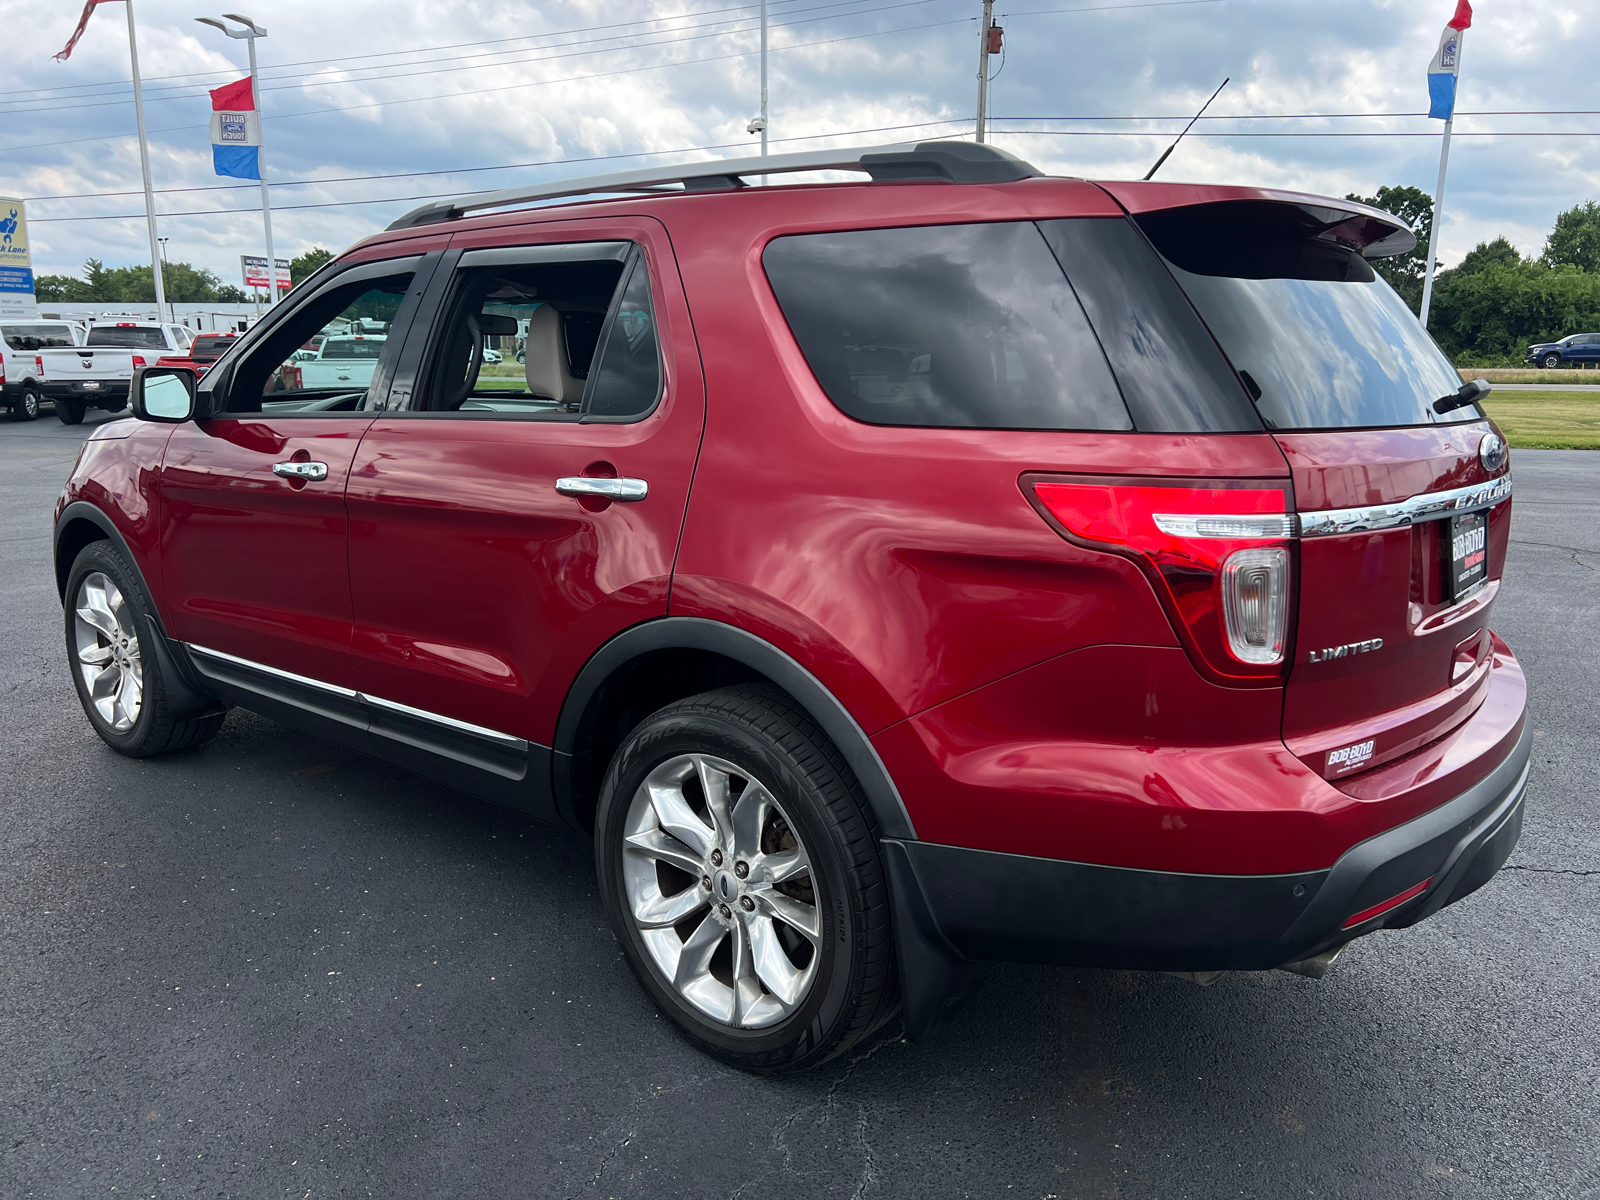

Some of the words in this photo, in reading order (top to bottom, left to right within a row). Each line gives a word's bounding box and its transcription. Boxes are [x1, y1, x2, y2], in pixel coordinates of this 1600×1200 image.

[8, 245, 26, 254] Lane
[1308, 638, 1384, 663] LIMITED
[836, 898, 846, 943] OUTSIDE
